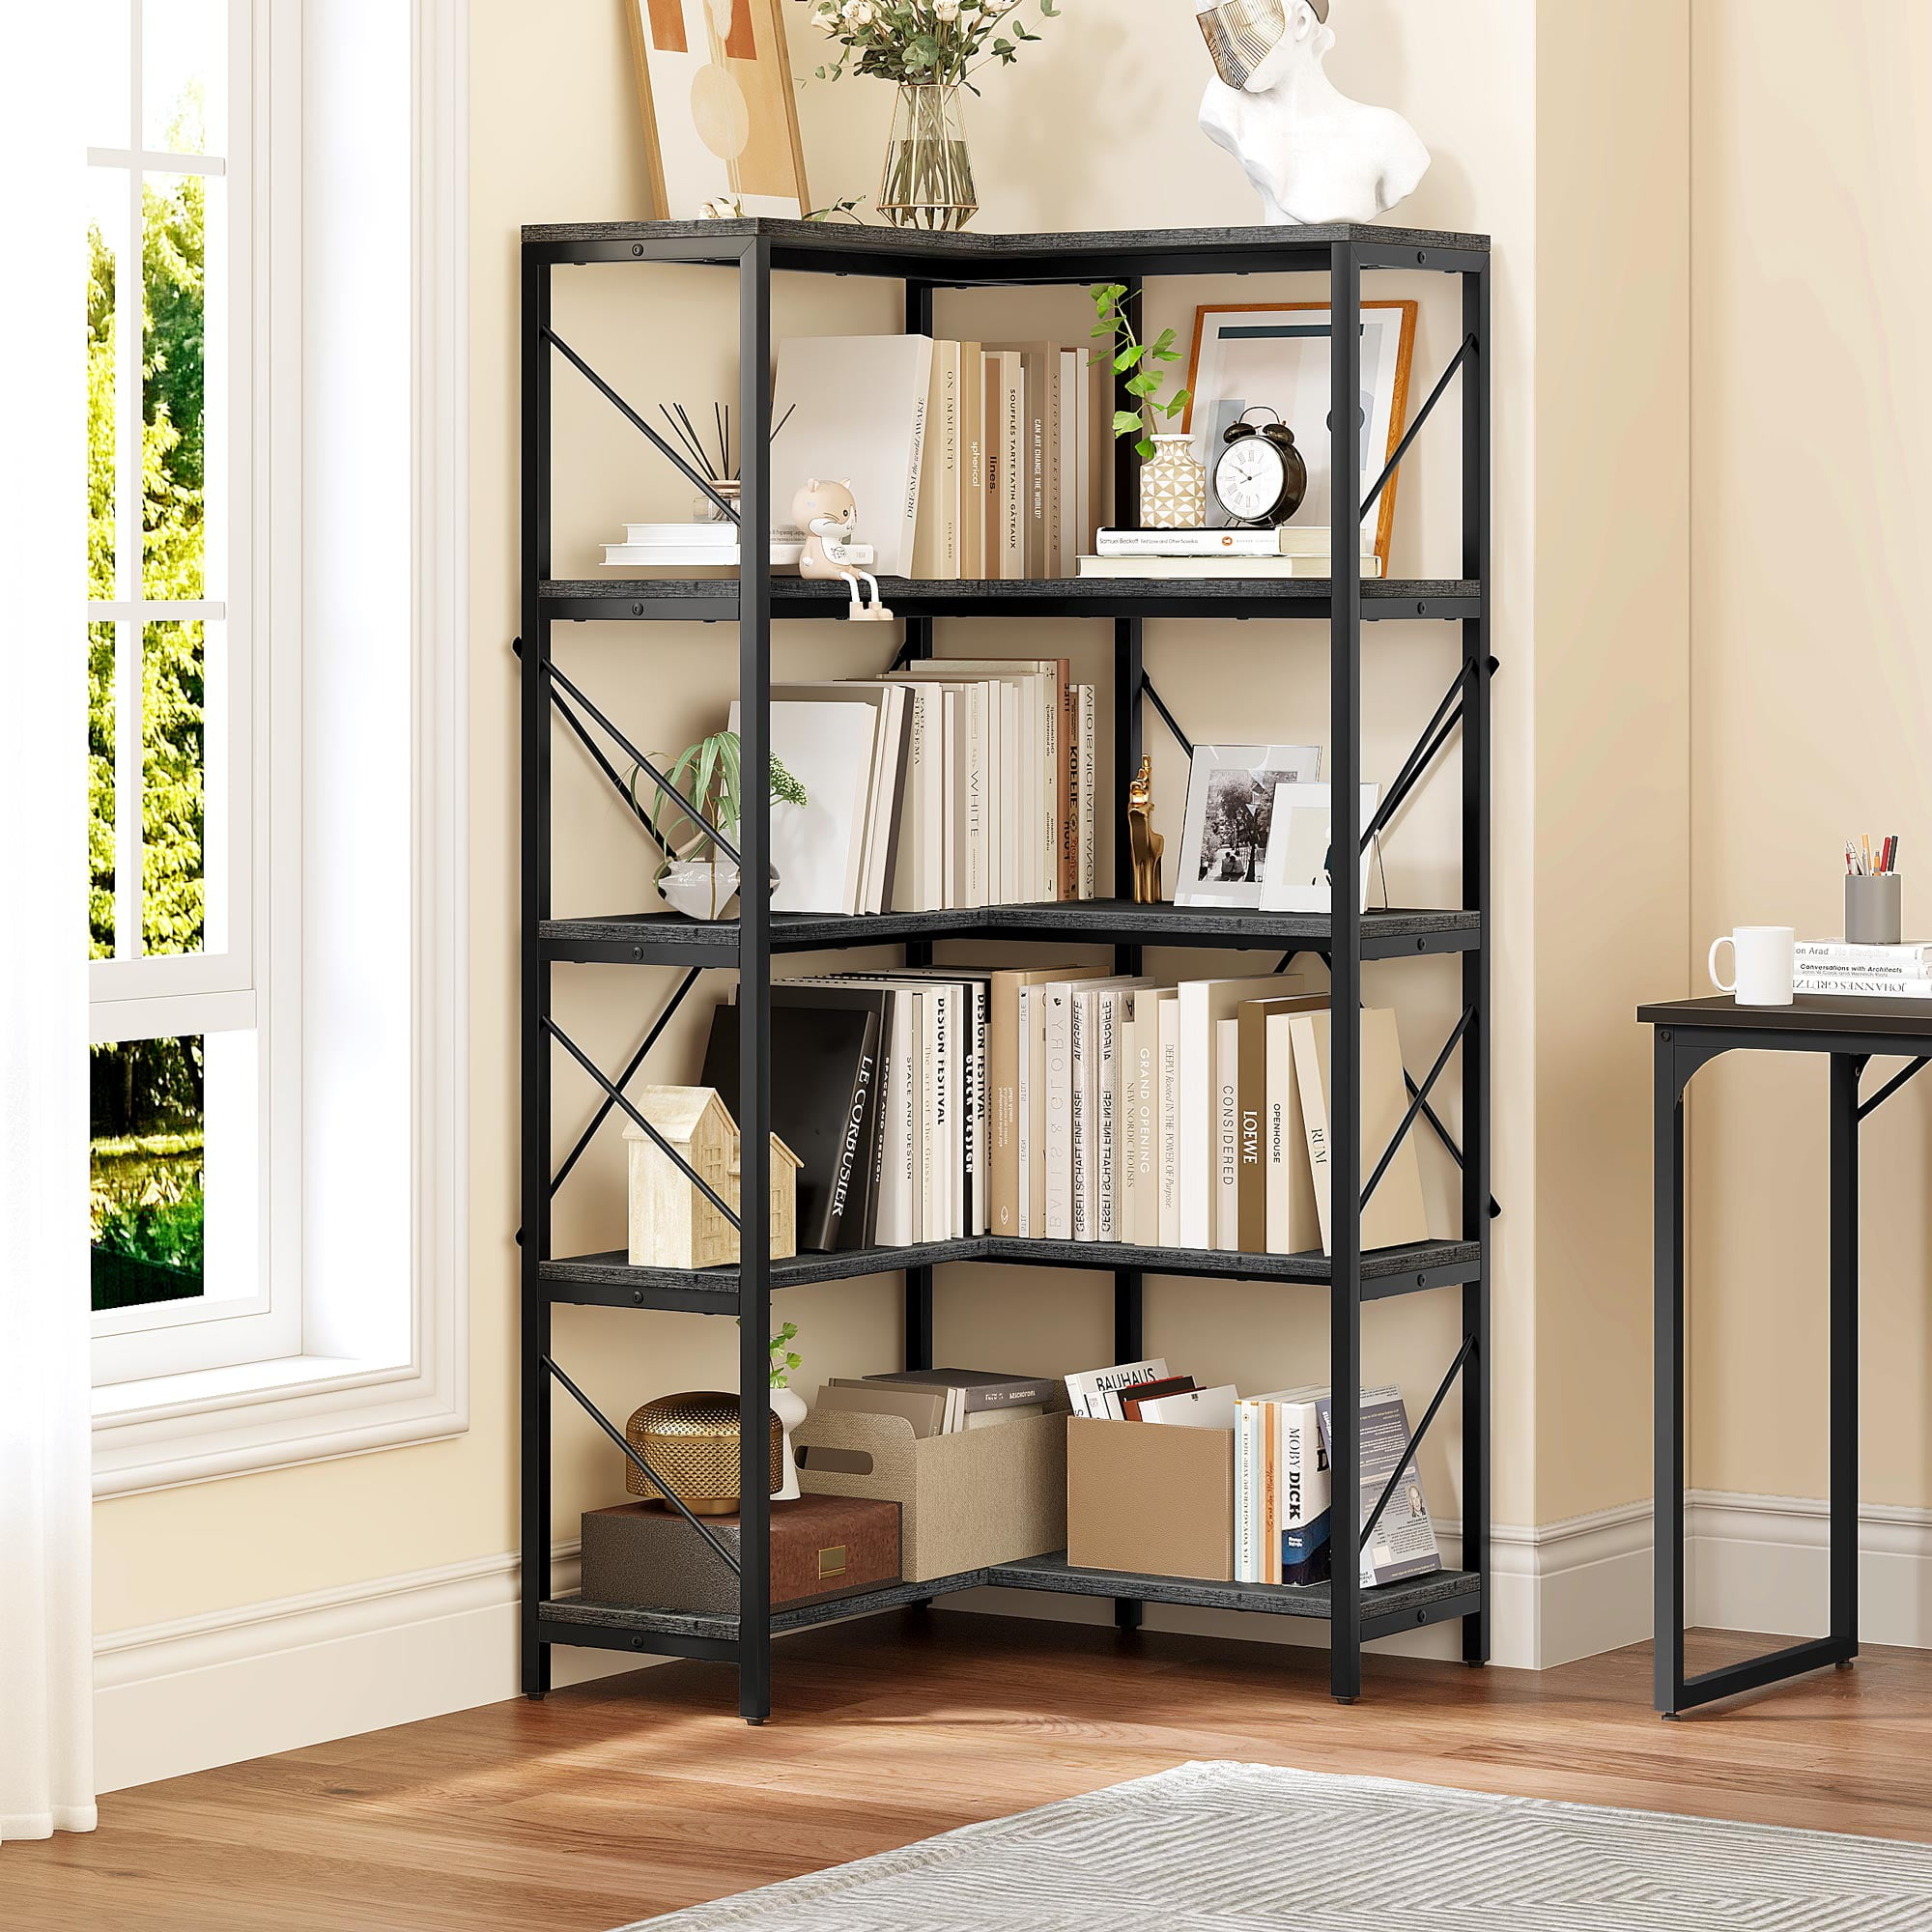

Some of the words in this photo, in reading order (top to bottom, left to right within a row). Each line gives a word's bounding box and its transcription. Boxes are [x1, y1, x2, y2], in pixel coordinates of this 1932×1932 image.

[947, 371, 953, 388] ON
[906, 476, 917, 519] DREAM
[915, 397, 924, 438] AWAKE
[970, 441, 980, 487] spherical
[970, 770, 979, 838] WHITE
[1800, 963, 1850, 972] Conversations
[1867, 965, 1903, 974] Architects
[1808, 947, 1830, 955] Arad
[1840, 980, 1907, 993] JOHANNES
[977, 994, 985, 1049] DESIGN
[858, 1055, 873, 1085] LE
[1140, 1047, 1151, 1099] GRAND
[1165, 1043, 1175, 1074] DEEPLY
[977, 1055, 985, 1121] FESTIVAL
[1165, 1075, 1175, 1103] Rooted
[1126, 1107, 1135, 1148] NORDIC
[1140, 1106, 1151, 1174] OPENING
[1165, 1114, 1175, 1132] THE
[1222, 1085, 1234, 1185] CONSIDERED
[1242, 1110, 1258, 1164] LOEWE
[832, 1088, 867, 1217] CORBUSIER
[1165, 1133, 1175, 1163] POWER
[1311, 1128, 1327, 1164] RUM
[1074, 1147, 1085, 1232] GESELLSCHAFT
[1126, 1150, 1135, 1188] HOUSES
[1165, 1165, 1175, 1178] OF
[1095, 1367, 1156, 1392] BAUHAUS
[1289, 1428, 1300, 1471] MOBY
[1289, 1471, 1300, 1520] DICK
